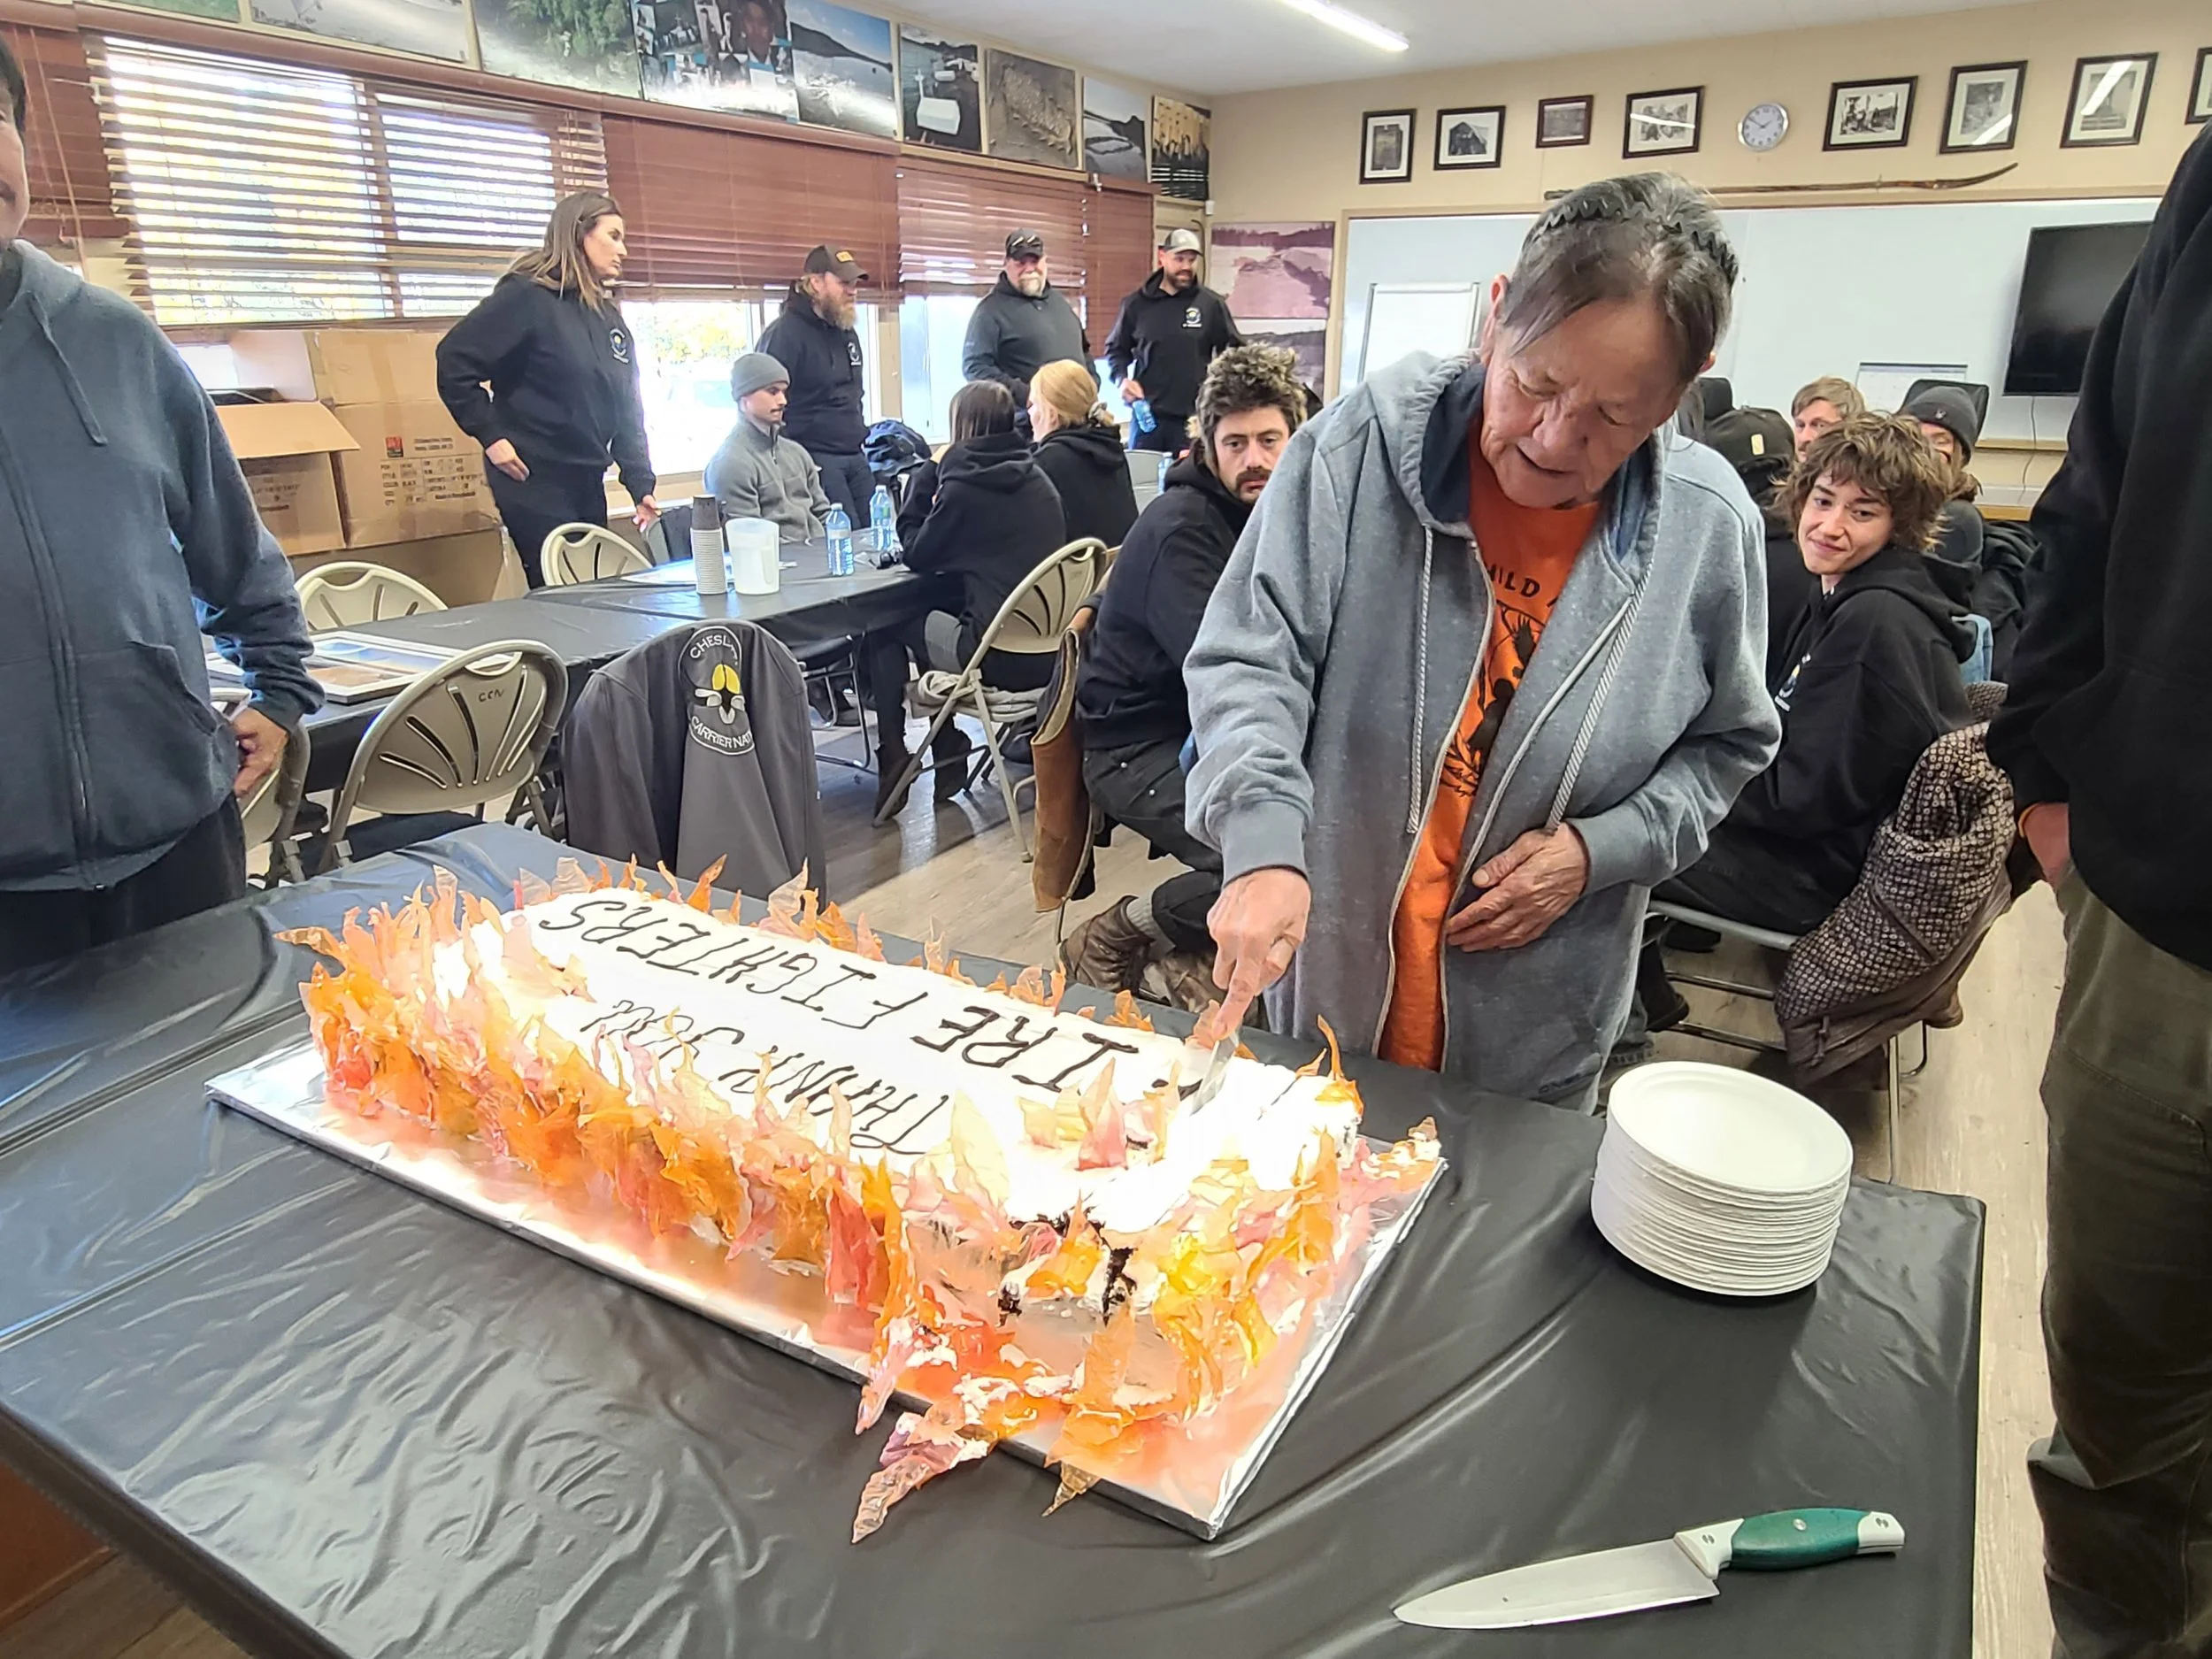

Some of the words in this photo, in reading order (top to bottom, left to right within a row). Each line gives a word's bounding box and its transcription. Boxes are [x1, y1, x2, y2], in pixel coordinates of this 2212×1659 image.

[1485, 561, 1540, 598] HILD
[691, 716, 733, 749] CARRIER
[538, 900, 929, 1030] FIGHTERS
[718, 1045, 949, 1155] THANK
